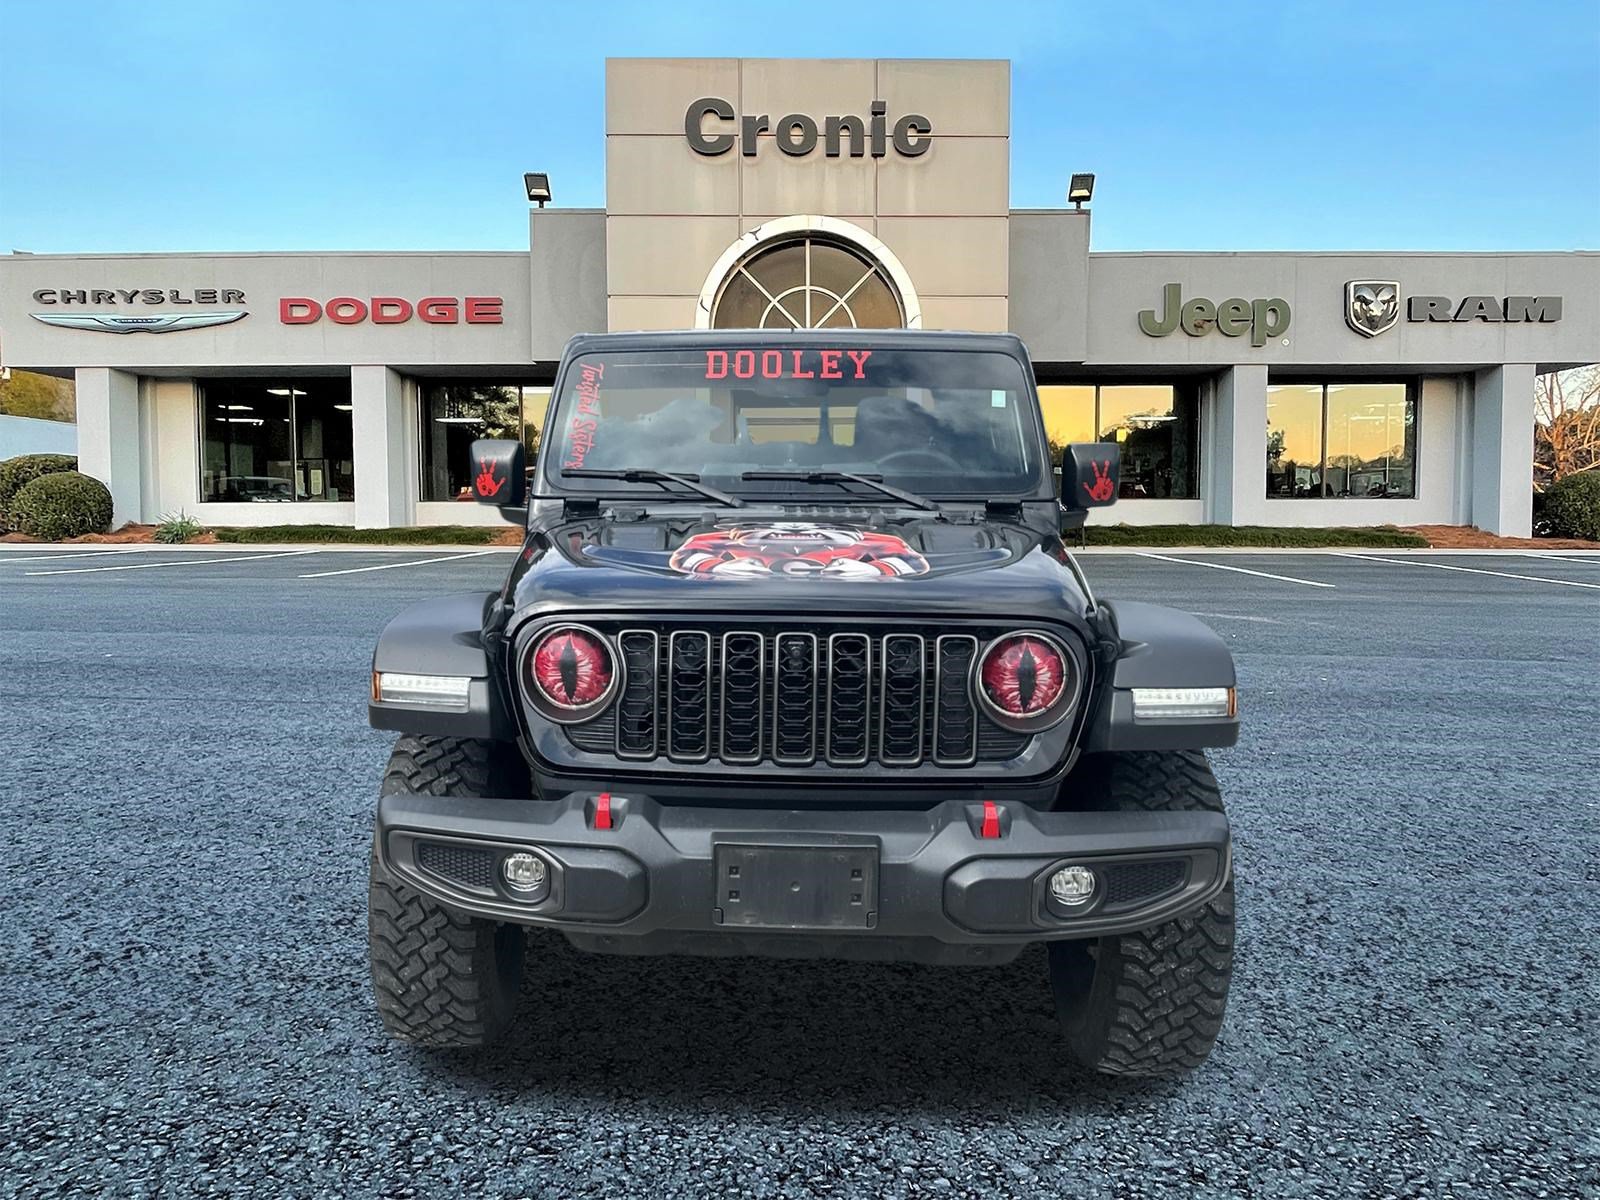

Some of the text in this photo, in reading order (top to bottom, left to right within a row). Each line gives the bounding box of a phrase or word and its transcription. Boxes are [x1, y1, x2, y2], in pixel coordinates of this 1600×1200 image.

[685, 97, 932, 157] Cronic
[32, 288, 246, 304] CHRYSLER
[1407, 296, 1563, 322] RAM
[280, 297, 504, 324] DODGE
[1138, 283, 1291, 347] Jeep
[705, 350, 872, 379] DOOLEY
